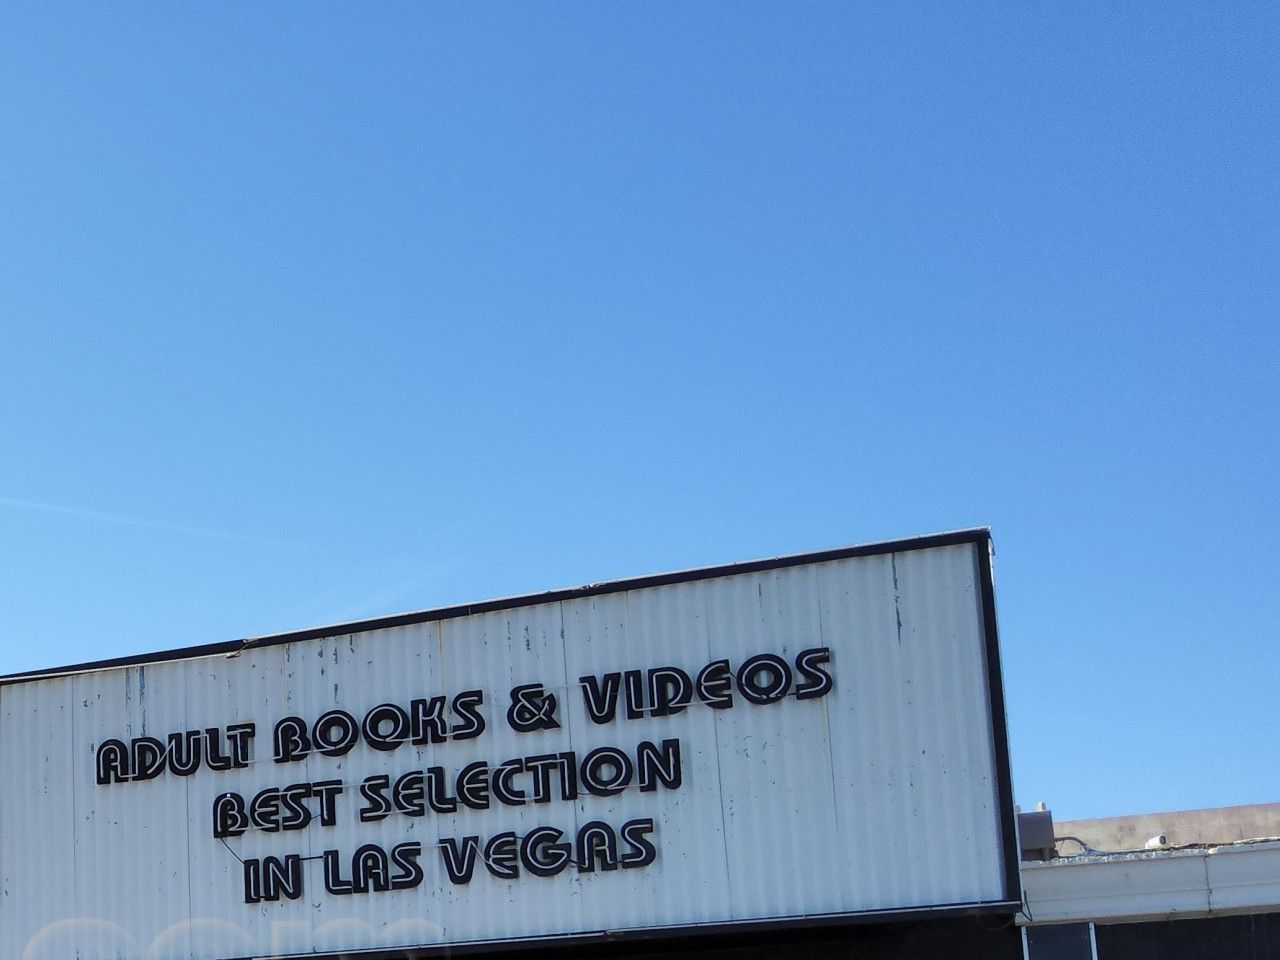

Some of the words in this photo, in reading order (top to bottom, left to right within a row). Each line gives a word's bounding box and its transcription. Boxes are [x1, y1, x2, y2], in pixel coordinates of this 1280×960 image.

[96, 723, 255, 785] ADULT
[273, 690, 486, 764] BOOKS
[507, 683, 560, 733] &
[581, 648, 833, 724] VIDEOS
[212, 780, 343, 839] BEST
[360, 739, 682, 822] SELECTION
[243, 854, 302, 904] IN
[323, 842, 423, 896] LAS
[440, 818, 657, 885] VEGAS
